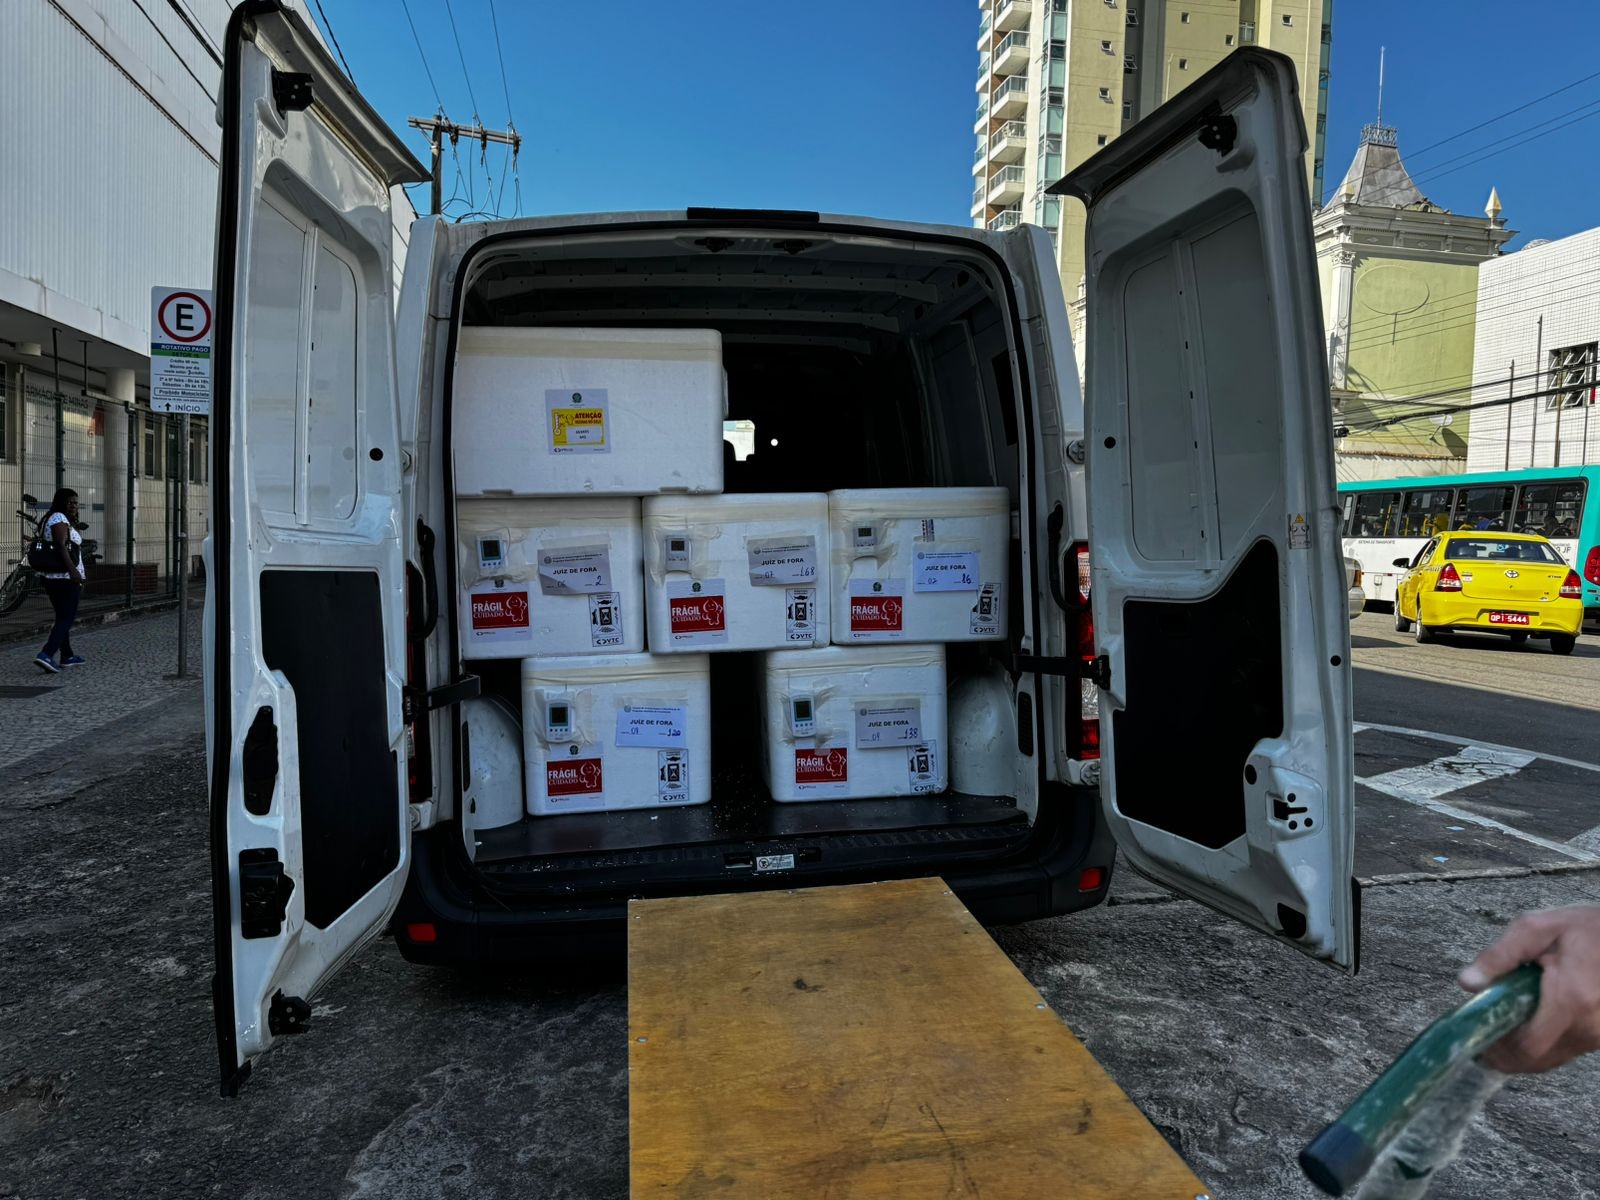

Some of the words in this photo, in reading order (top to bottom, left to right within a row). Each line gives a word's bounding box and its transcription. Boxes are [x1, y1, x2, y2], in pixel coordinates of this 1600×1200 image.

[176, 303, 194, 331] E
[160, 344, 191, 352] ROTATIVO
[175, 403, 201, 412] INÍCIO
[575, 411, 602, 420] ATENÇÃO
[473, 600, 504, 613] FRÁGIL
[671, 604, 700, 617] FRÁGIL
[852, 603, 880, 615] FRÁGIL
[473, 610, 504, 619] CUIDADO
[671, 614, 701, 623] CUIDADO
[852, 613, 880, 621] CUIDADO
[797, 756, 825, 767] FRÁGIL
[548, 767, 578, 780] FRÁGIL
[548, 777, 578, 785] CUIDADO
